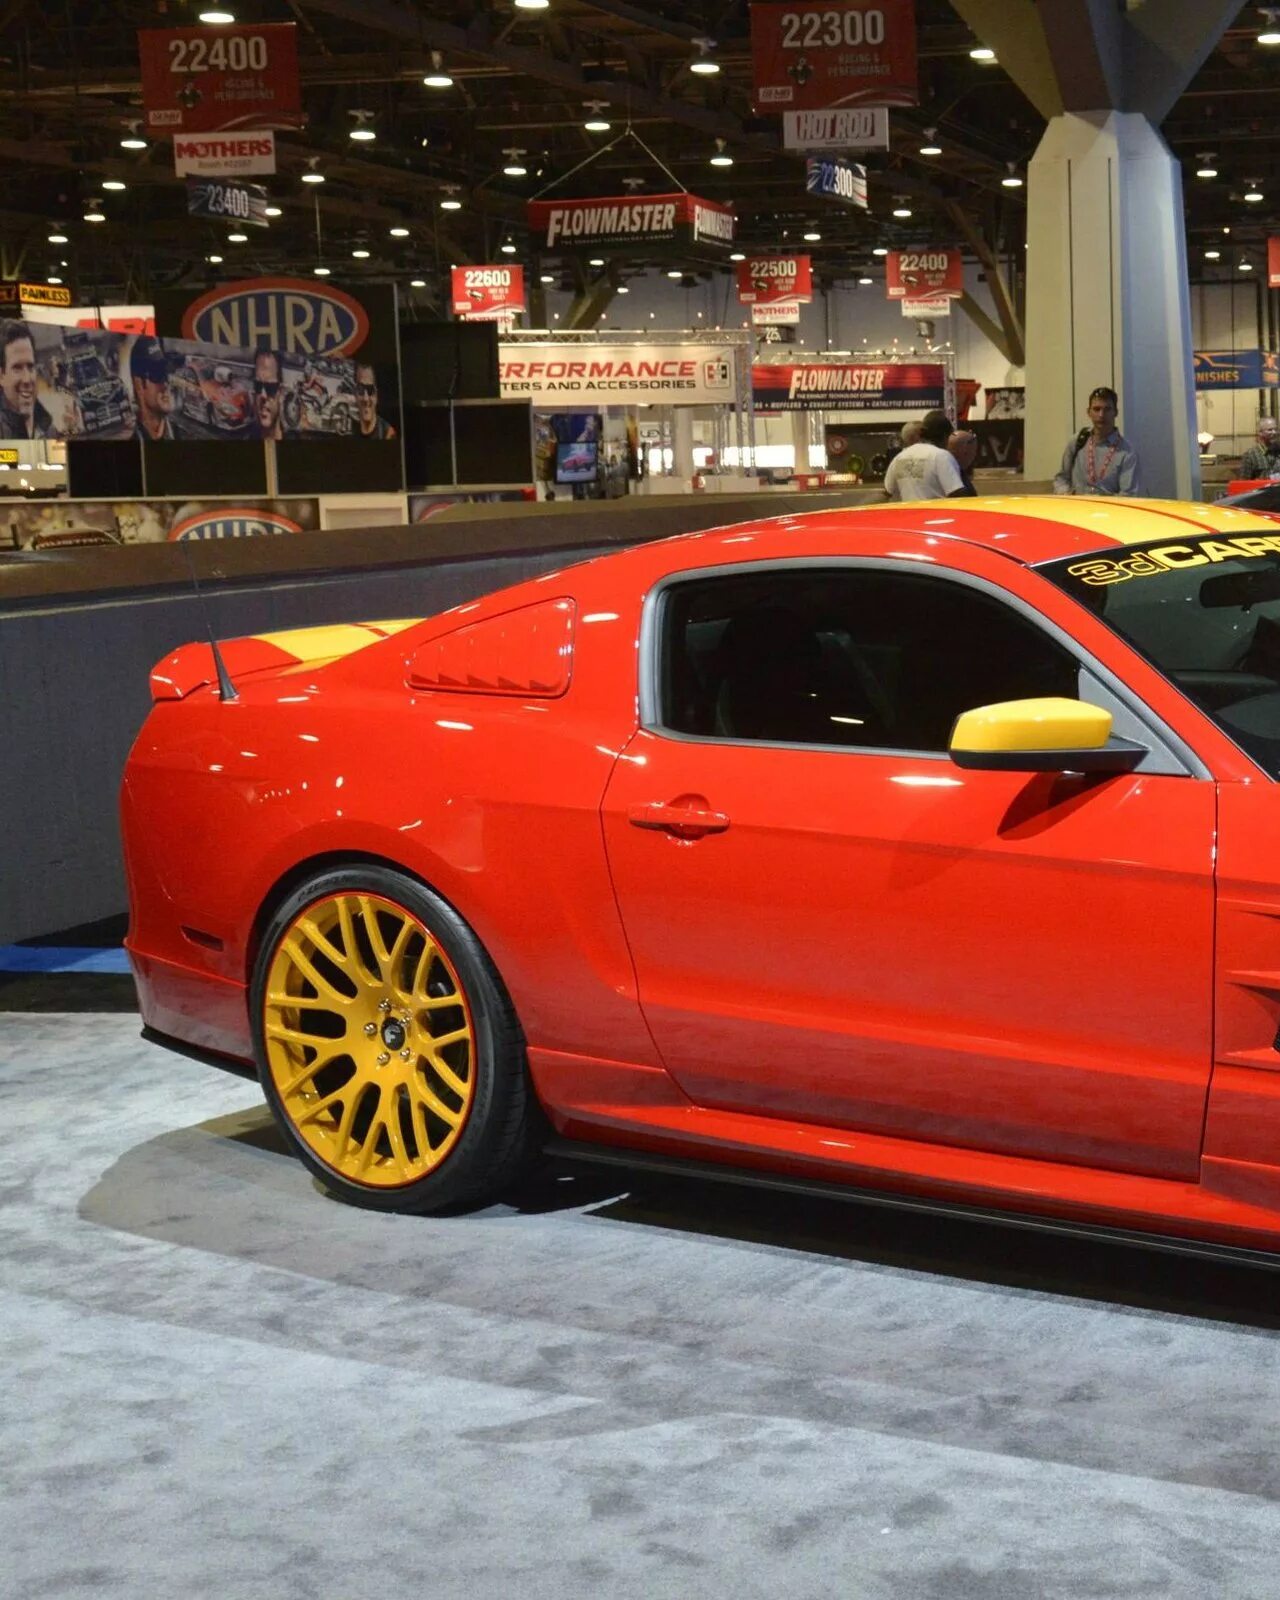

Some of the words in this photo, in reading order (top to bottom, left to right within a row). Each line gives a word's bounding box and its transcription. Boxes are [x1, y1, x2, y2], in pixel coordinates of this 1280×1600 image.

[781, 10, 884, 48] 22300
[168, 37, 268, 72] 22400
[176, 139, 272, 159] MOTHERS
[820, 162, 852, 198] 22300
[207, 184, 249, 217] 23400
[547, 204, 676, 247] FLOWMASTER
[750, 260, 797, 278] 22500
[899, 254, 948, 271] 22400
[465, 269, 510, 288] 22600
[21, 287, 69, 303] PAINLESS
[210, 295, 343, 351] NHRA
[752, 306, 799, 315] MOTHERS
[544, 380, 582, 390] AND
[585, 379, 696, 390] ACCESSORIES
[789, 369, 884, 399] FLOWMASTER
